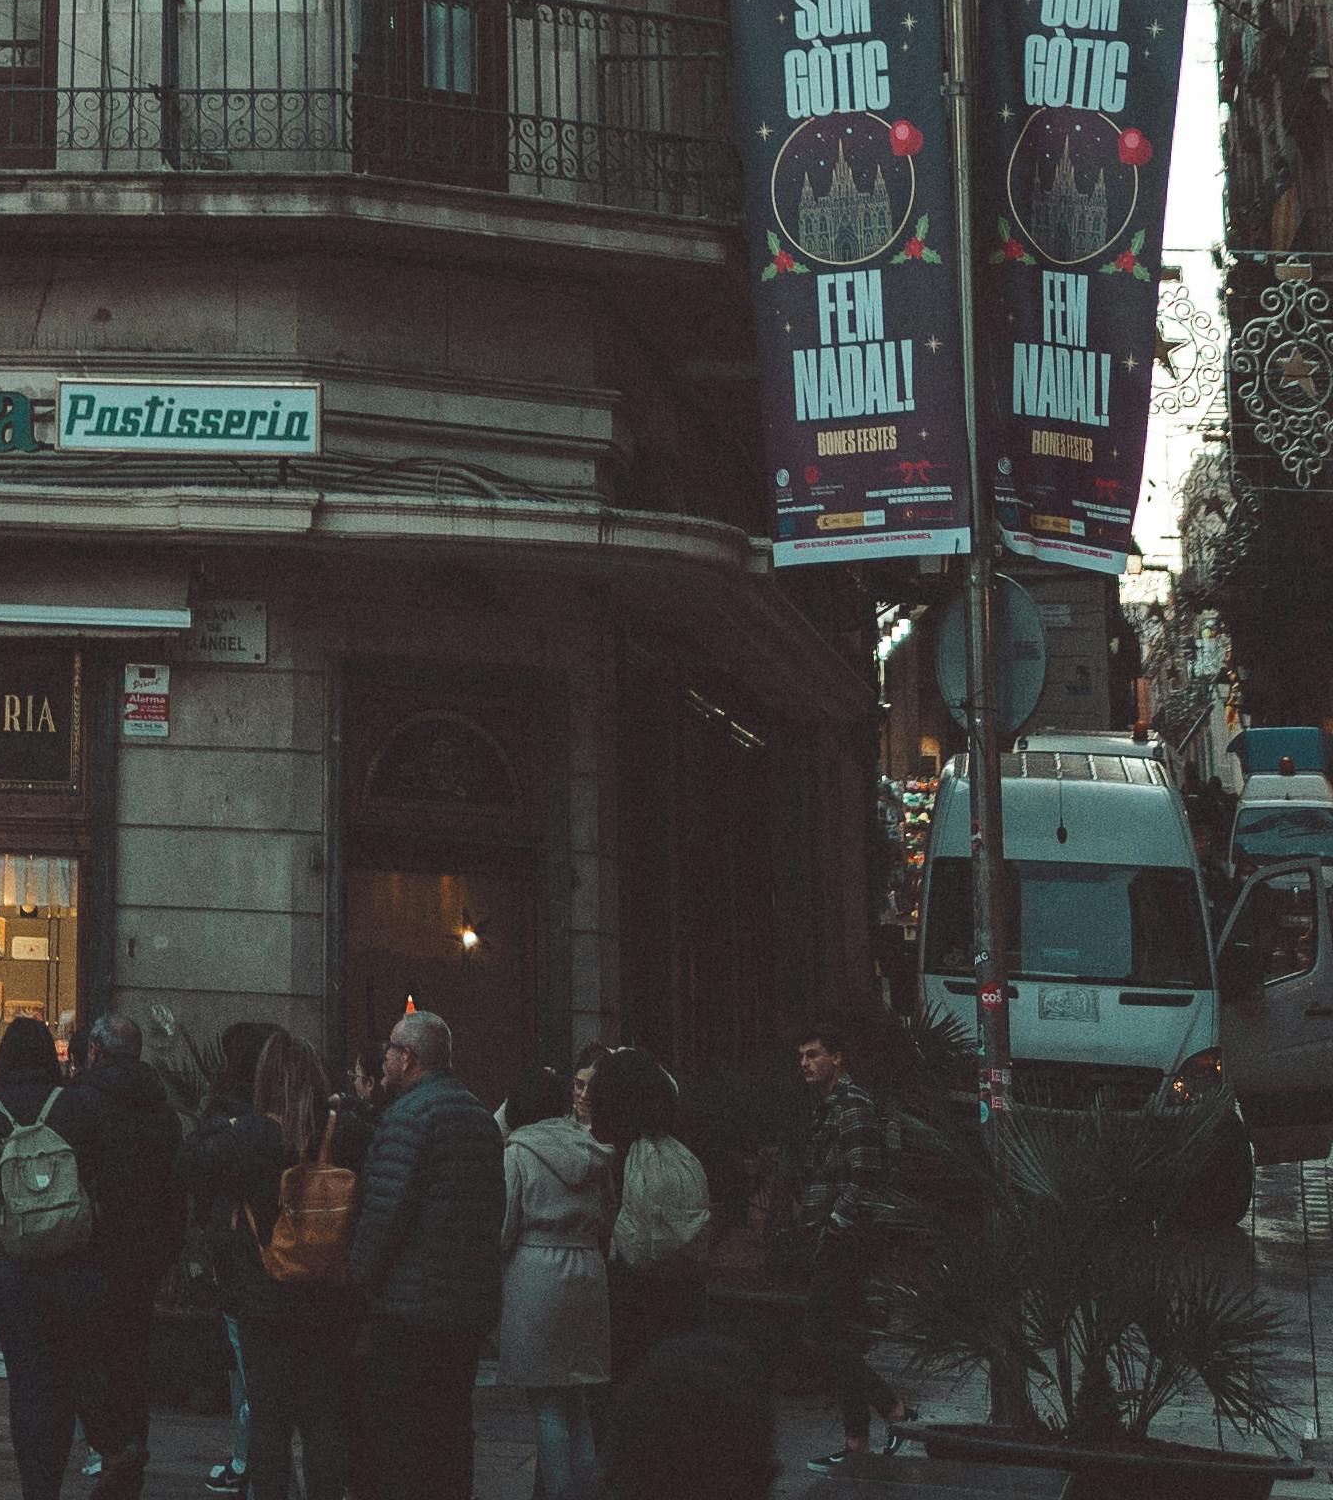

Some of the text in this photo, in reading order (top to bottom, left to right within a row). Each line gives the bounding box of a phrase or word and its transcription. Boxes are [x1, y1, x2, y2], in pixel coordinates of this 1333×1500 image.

[784, 39, 891, 120] GÒTIC
[1024, 28, 1130, 113] GÒTIC
[817, 269, 884, 345] FEM
[1042, 270, 1089, 348] FEM
[64, 394, 311, 442] Pastisseria
[793, 339, 915, 421] NADAL!
[1013, 342, 1111, 428] NADAL!
[817, 426, 898, 457] BONES FESTES
[1031, 430, 1094, 463] BONES FESTES
